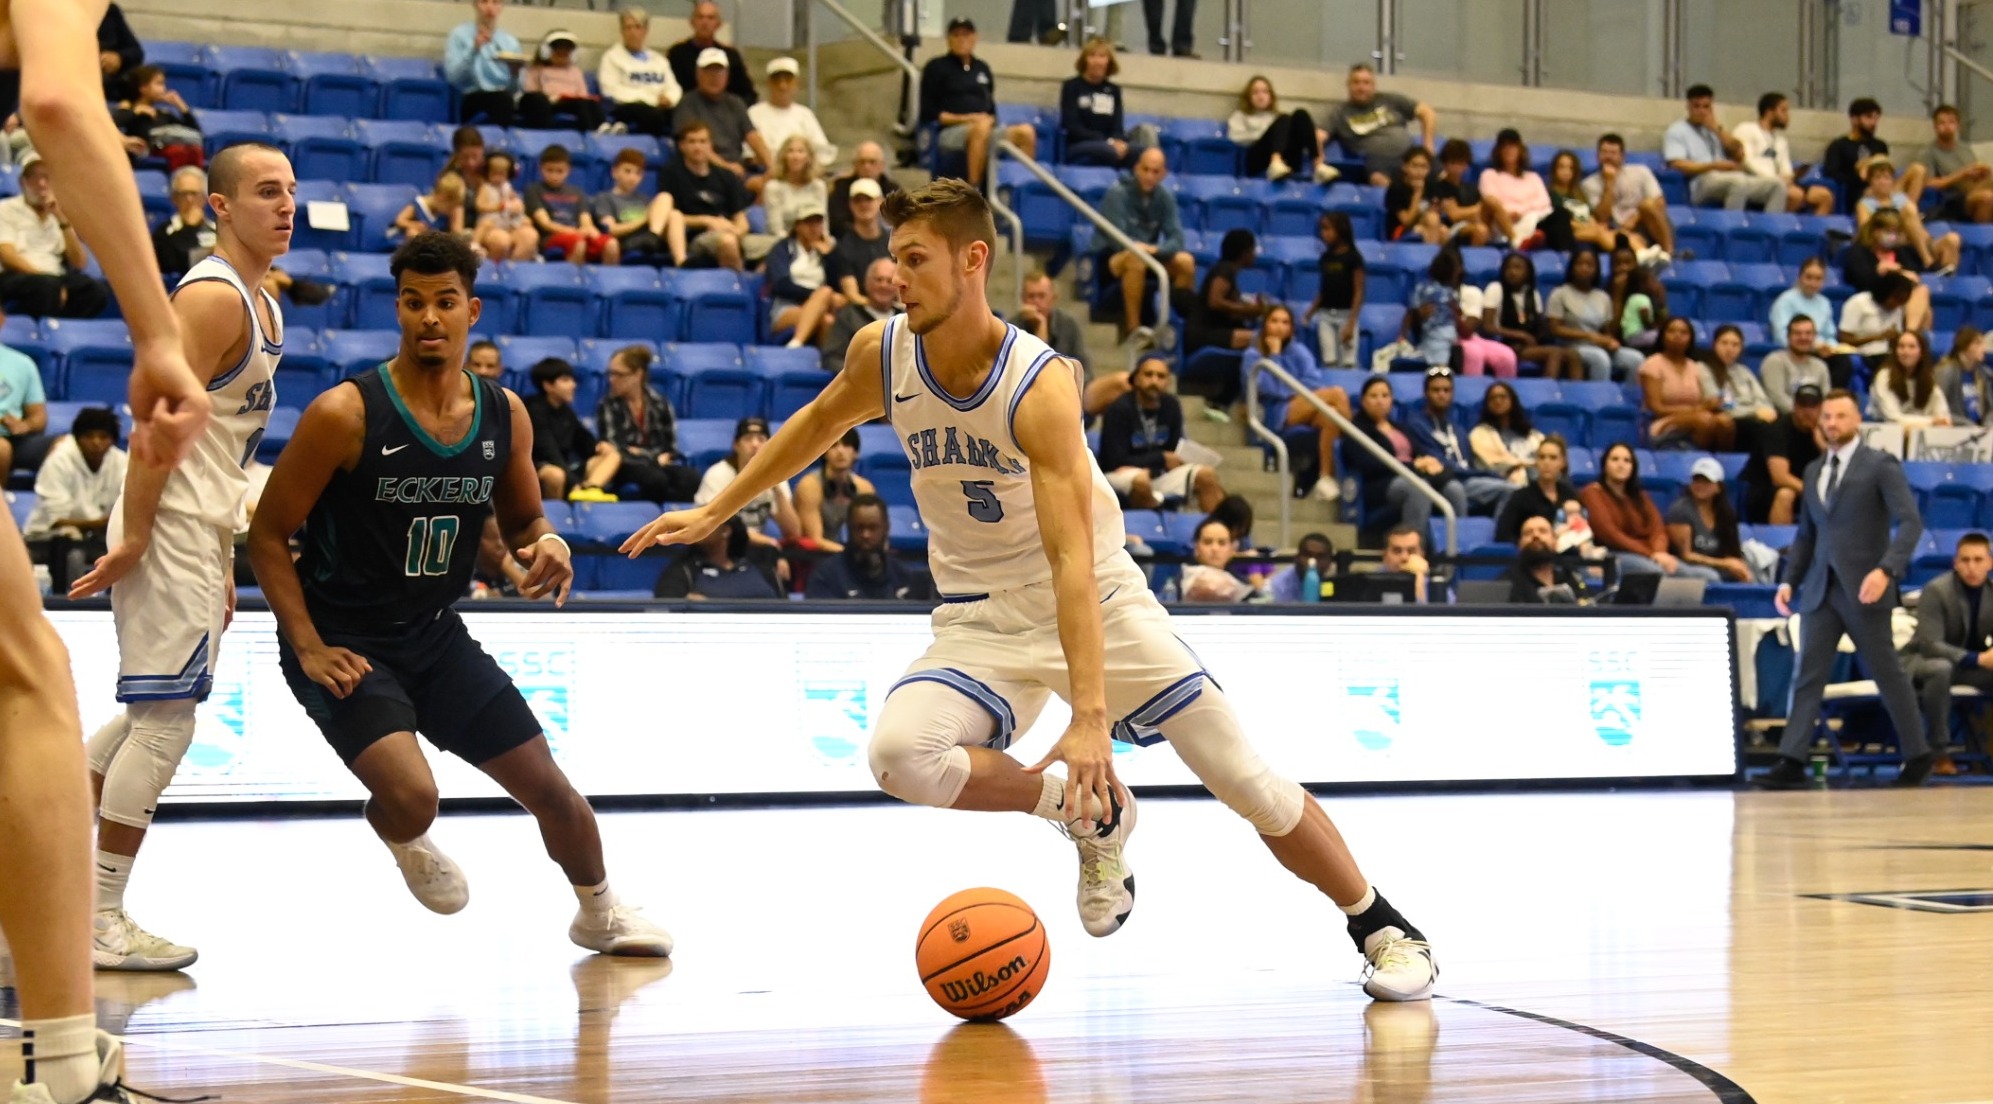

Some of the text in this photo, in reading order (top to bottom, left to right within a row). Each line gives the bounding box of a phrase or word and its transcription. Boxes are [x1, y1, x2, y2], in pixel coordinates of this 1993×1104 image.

[375, 476, 494, 504] ECKERD
[960, 479, 1004, 523] 5
[405, 515, 460, 577] 10
[498, 651, 567, 676] SSC
[1587, 650, 1638, 673] SSC
[940, 955, 1027, 1003] Wilson
